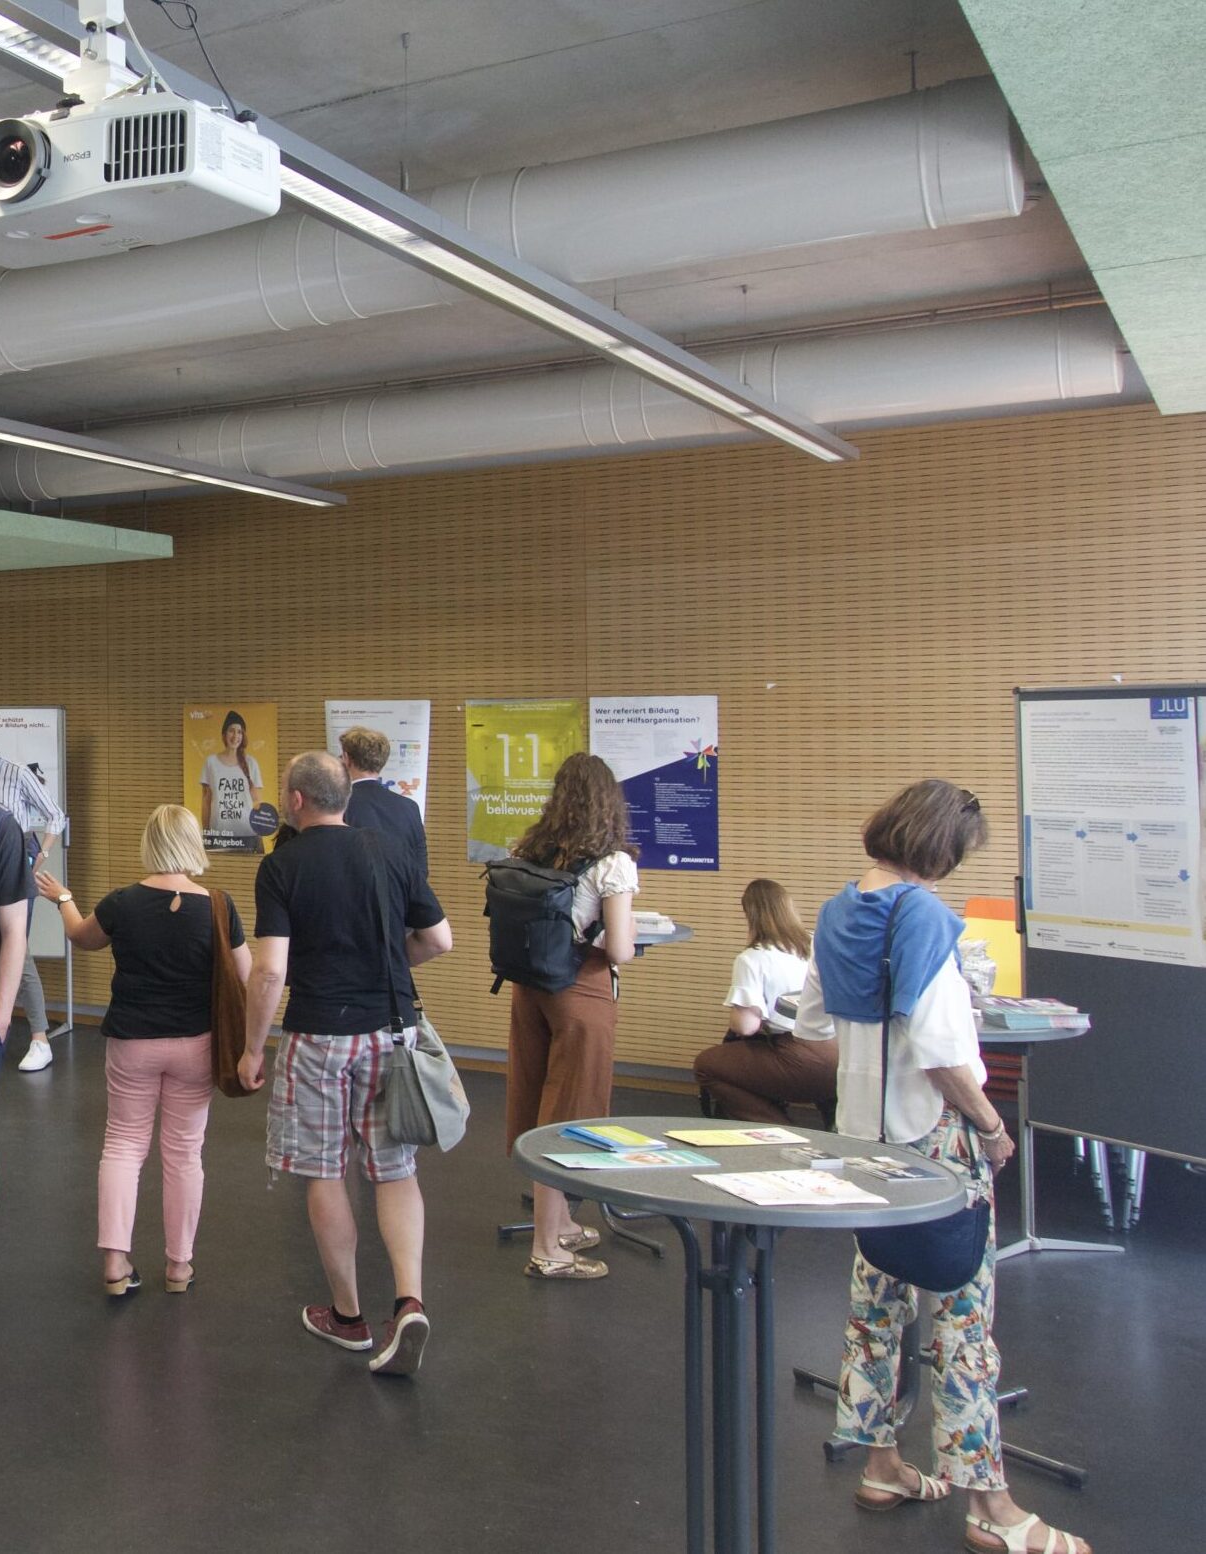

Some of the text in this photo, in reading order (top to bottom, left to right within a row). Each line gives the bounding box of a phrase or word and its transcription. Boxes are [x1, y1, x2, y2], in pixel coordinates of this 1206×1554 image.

[63, 151, 91, 163] EPSON
[1158, 698, 1186, 712] JLU
[648, 707, 679, 715] Bildung
[627, 716, 700, 724] Hilfsorganisation?
[496, 733, 539, 777] 1:1
[218, 777, 245, 792] FARB
[224, 792, 240, 800] MIT
[219, 800, 244, 810] MISCH
[486, 802, 547, 815] bellevue-s
[220, 810, 242, 820] ERIN
[213, 838, 245, 847] Angebot.
